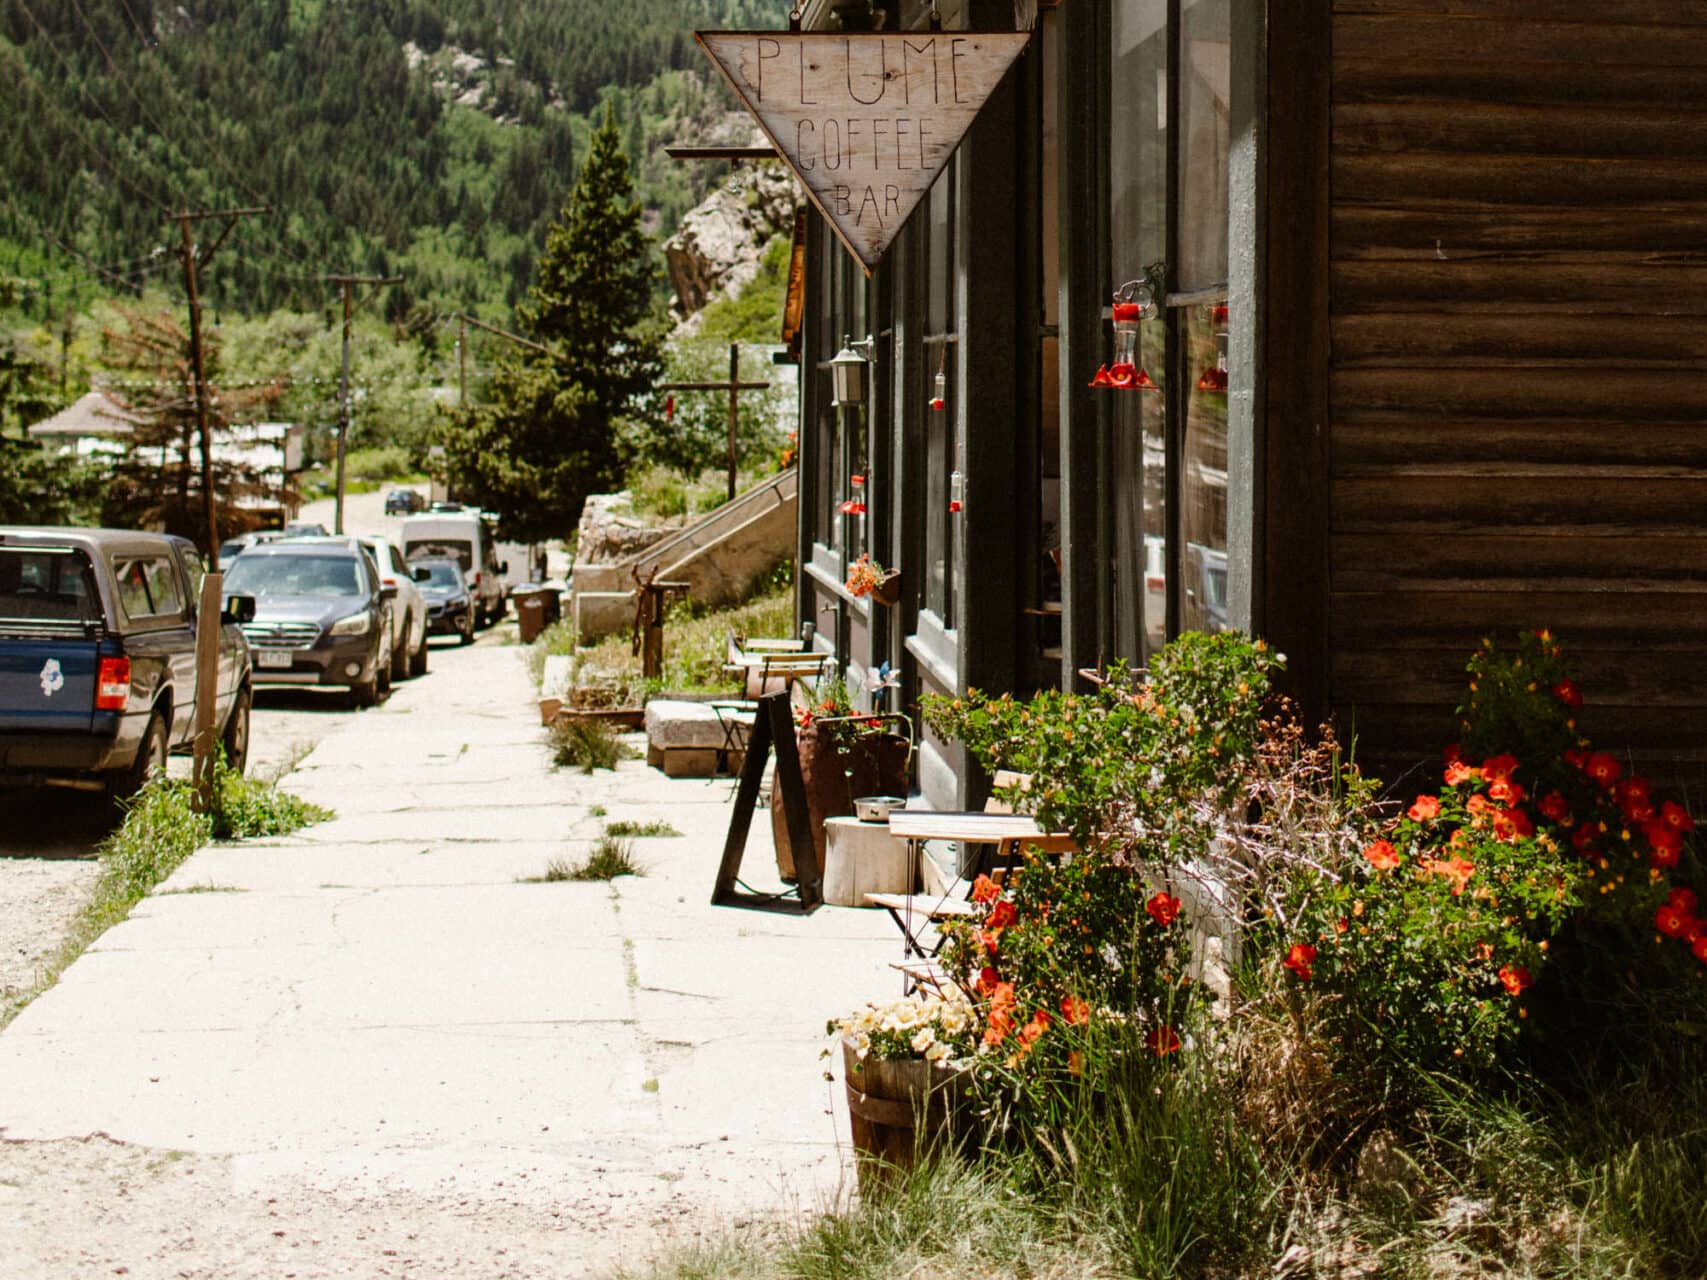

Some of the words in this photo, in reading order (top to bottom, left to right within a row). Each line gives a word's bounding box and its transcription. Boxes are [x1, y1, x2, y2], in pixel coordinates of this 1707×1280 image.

[757, 38, 969, 105] PLUME
[796, 118, 935, 171] COFFEE
[834, 184, 901, 227] BAR
